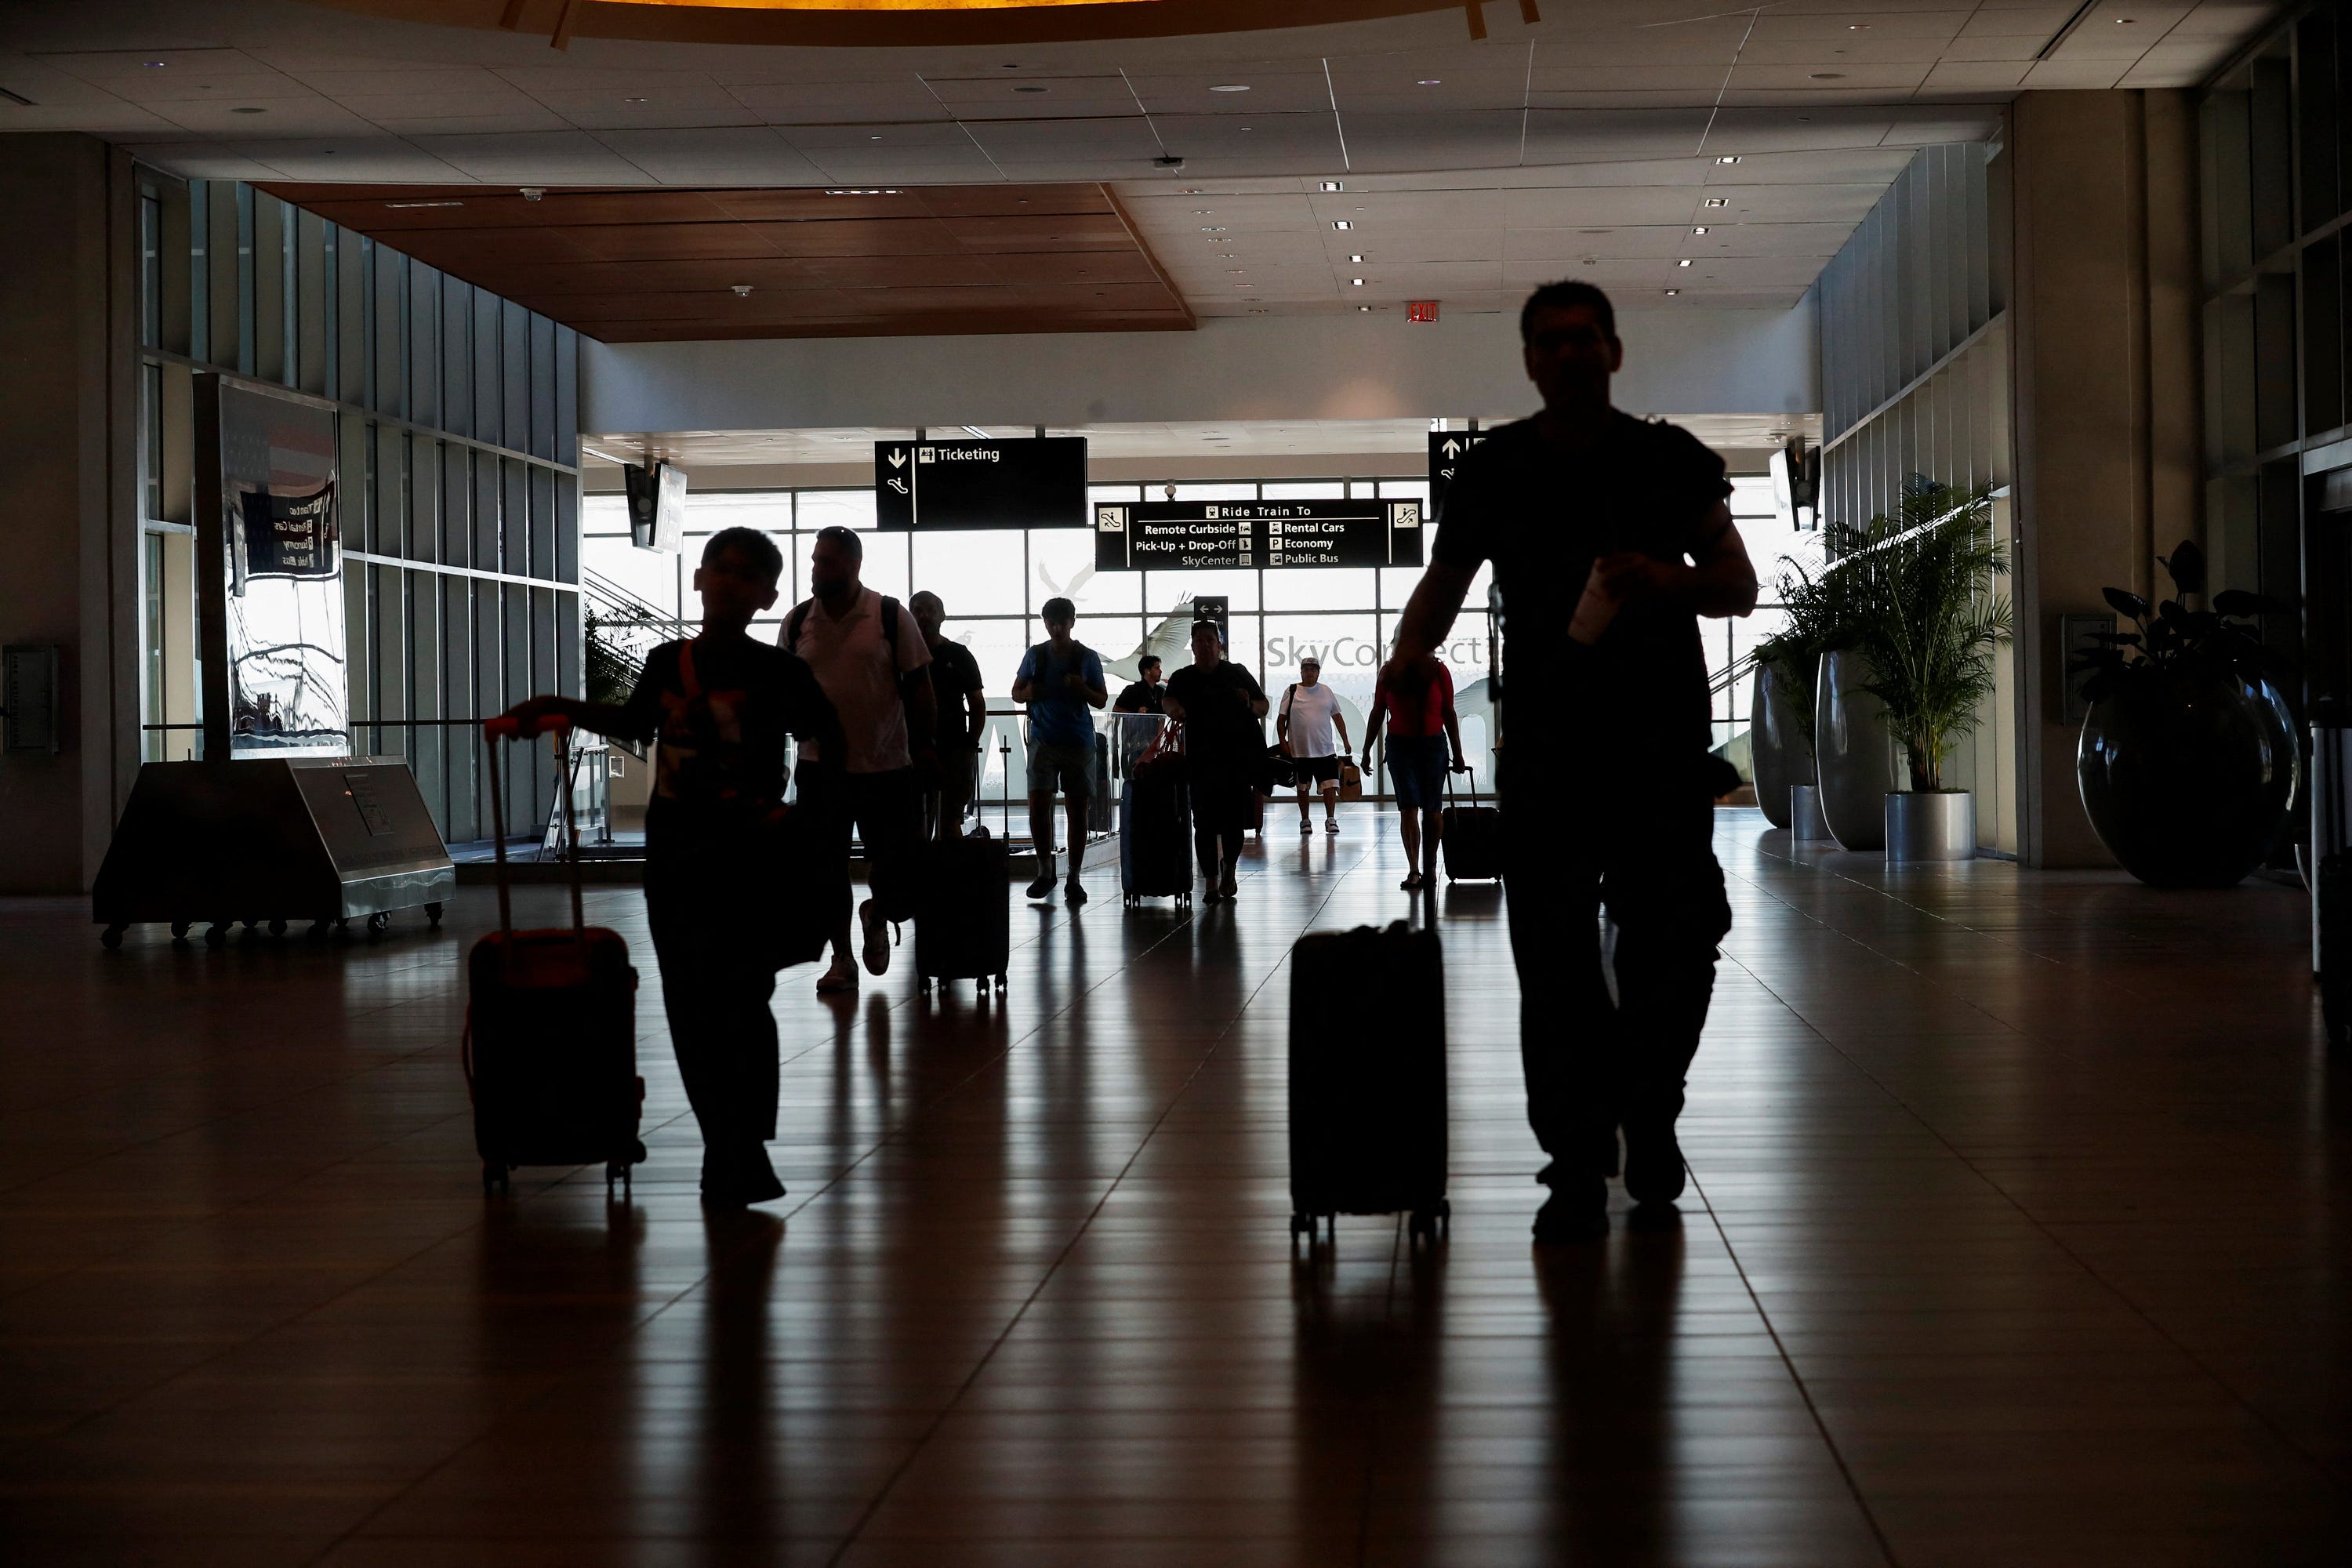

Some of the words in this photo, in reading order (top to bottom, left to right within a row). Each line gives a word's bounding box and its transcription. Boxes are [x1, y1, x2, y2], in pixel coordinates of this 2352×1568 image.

[1411, 303, 1436, 320] EXIT
[938, 448, 1000, 463] Ticketing
[1221, 506, 1250, 517] Ride
[1257, 506, 1290, 517] Train
[1297, 506, 1311, 516] To
[1145, 524, 1186, 535] Remote
[1189, 523, 1236, 535] Curbside
[1284, 521, 1319, 533] Rental
[1321, 523, 1345, 532] Cars
[1136, 541, 1176, 552] Pick-Up
[1189, 539, 1236, 552] Drop-Off
[1284, 539, 1334, 550] Economy
[1181, 555, 1236, 568] SkyCenter
[1285, 554, 1317, 564] Public
[1319, 554, 1339, 563] Bus
[1267, 636, 1482, 674] SkyCoect
